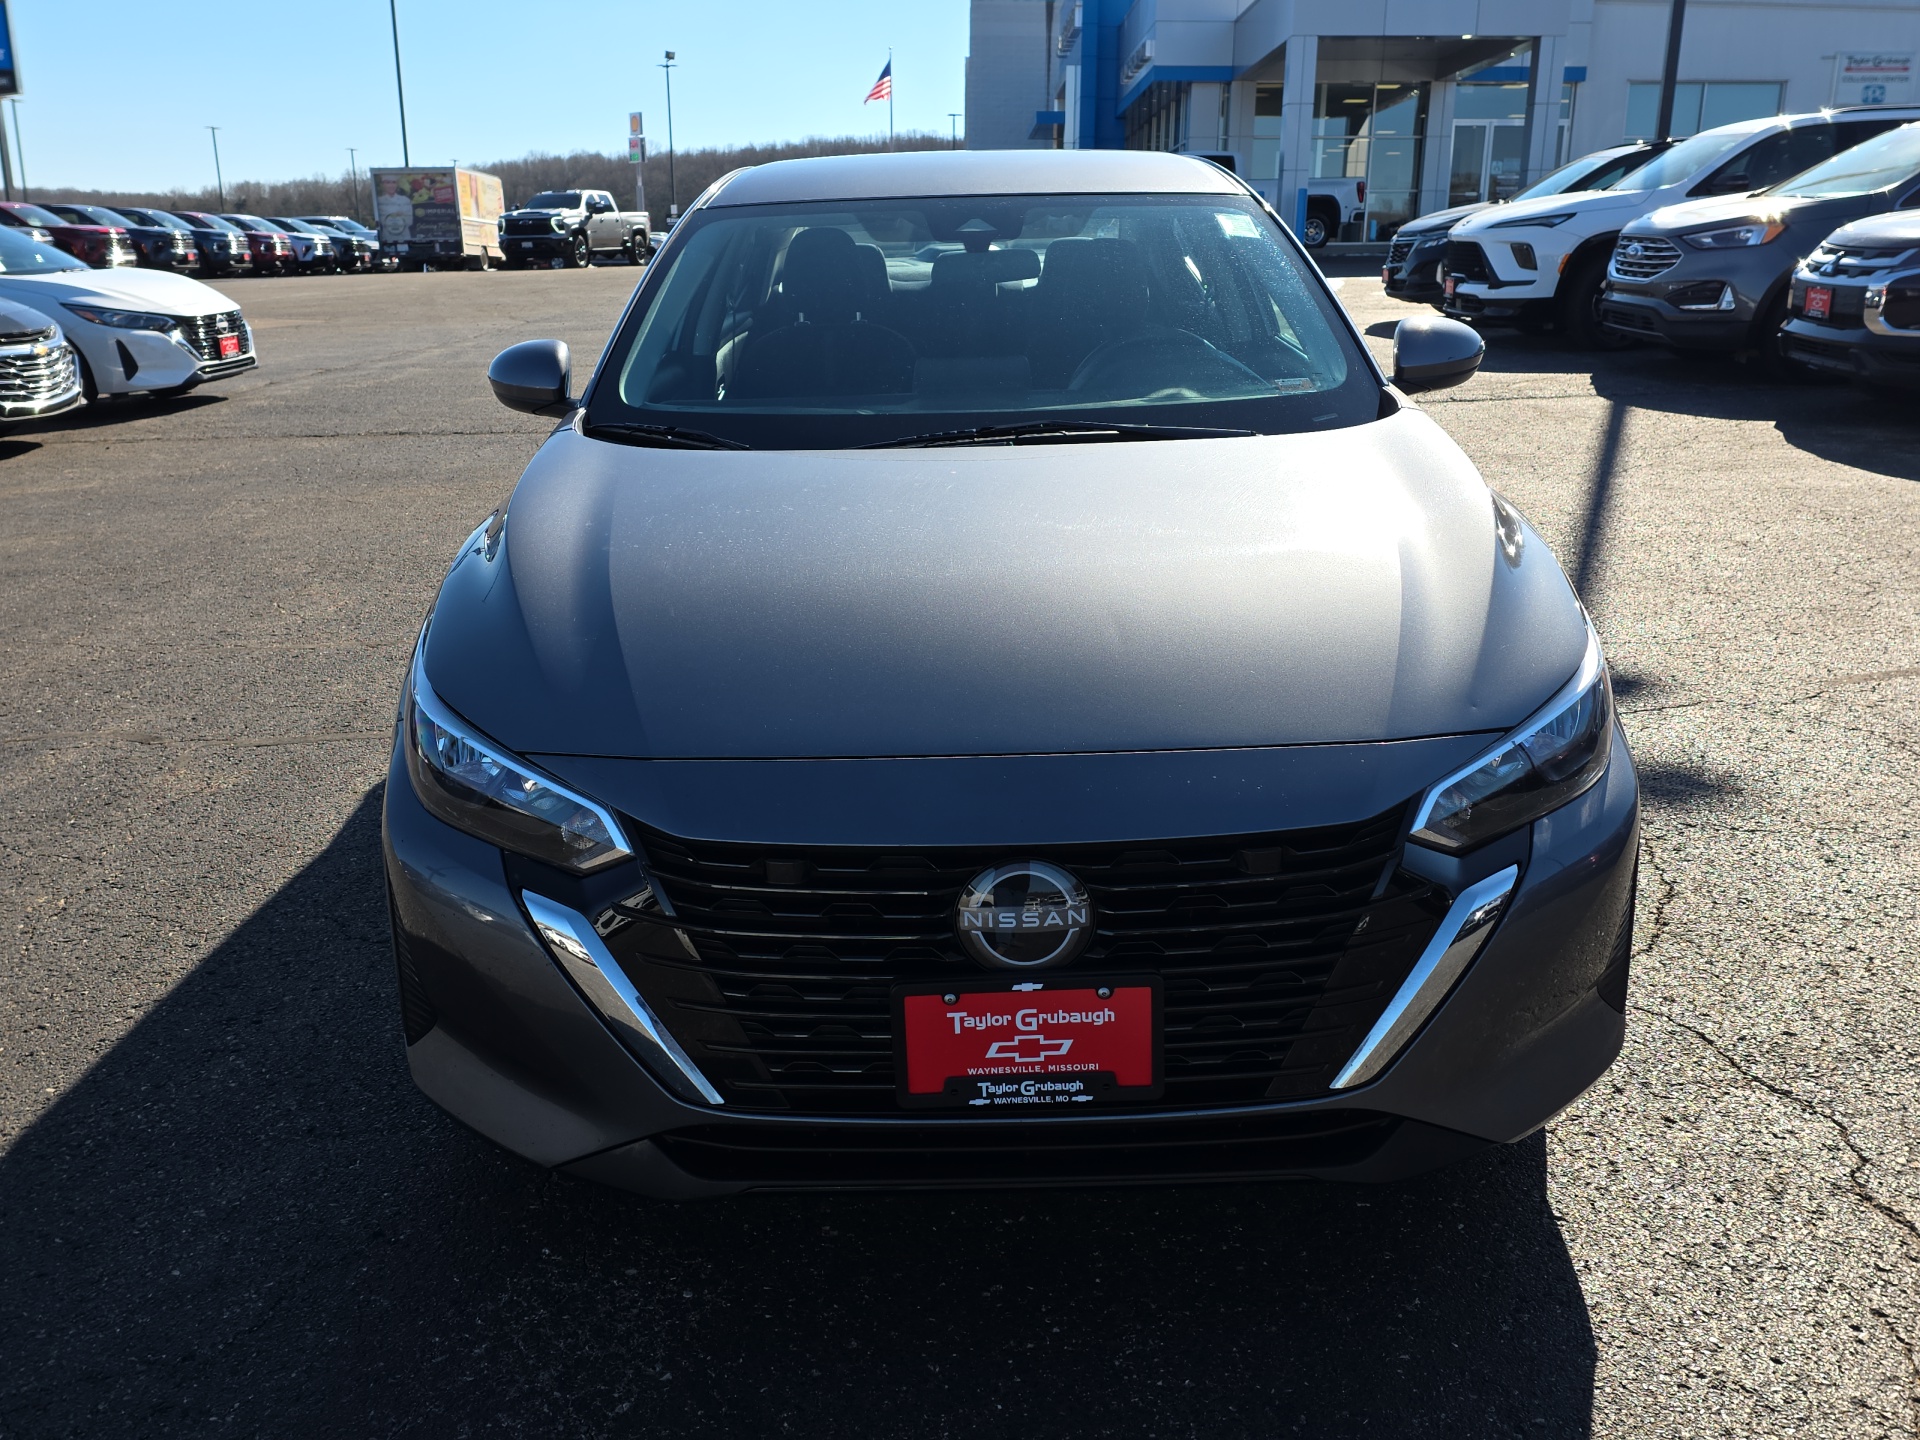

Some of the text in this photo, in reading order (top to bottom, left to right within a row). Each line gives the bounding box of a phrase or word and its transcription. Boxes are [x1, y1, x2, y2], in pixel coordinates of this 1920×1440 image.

[963, 908, 1087, 928] NISSAN
[946, 1008, 1115, 1035] Taylor Grubaugh
[967, 1063, 1099, 1075] WAYNESVILLE, MISSOURI
[977, 1080, 1084, 1097] Taylor Grubaugh
[993, 1095, 1069, 1105] WAYNESVILLE, MO
